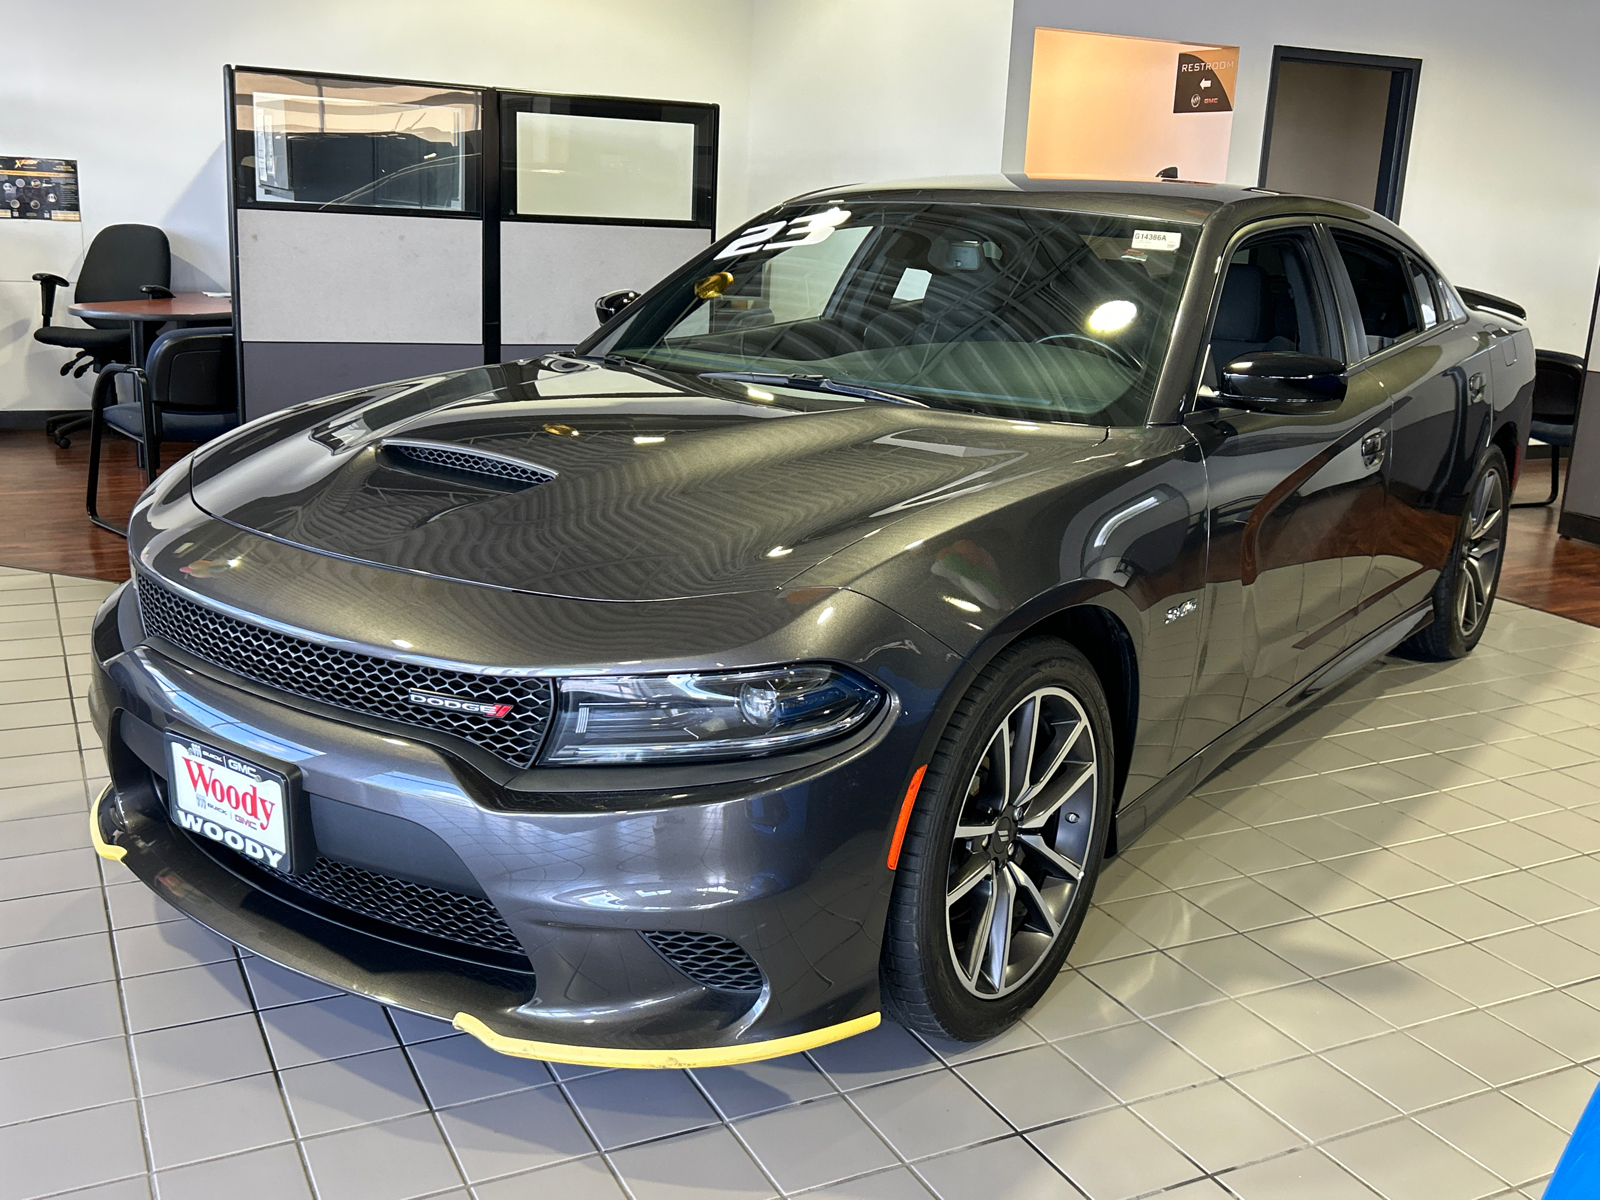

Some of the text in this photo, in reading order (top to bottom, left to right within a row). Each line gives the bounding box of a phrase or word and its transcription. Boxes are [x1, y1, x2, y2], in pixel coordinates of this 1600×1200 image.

[1181, 61, 1234, 72] RESTROOM
[713, 207, 851, 260] 23
[410, 694, 497, 714] DODGE
[228, 759, 256, 776] GMC
[182, 756, 275, 831] Woody
[177, 810, 282, 868] WOODY
